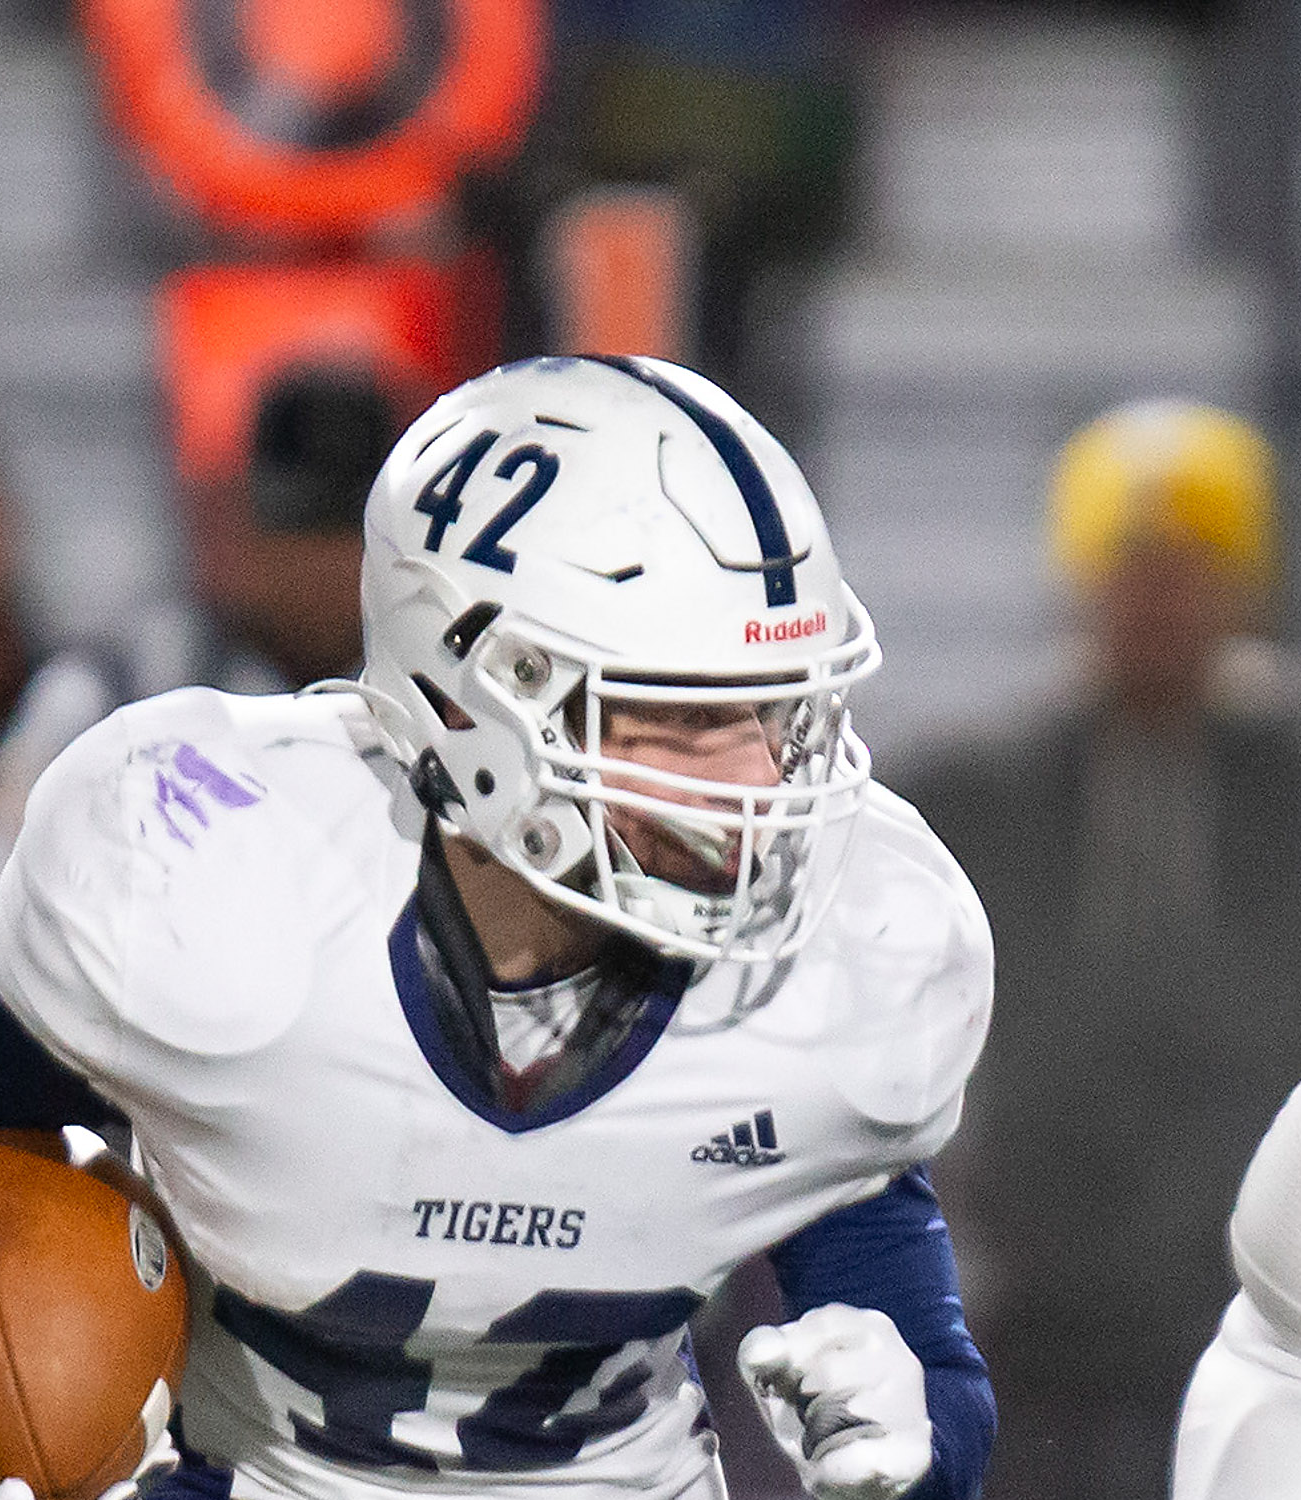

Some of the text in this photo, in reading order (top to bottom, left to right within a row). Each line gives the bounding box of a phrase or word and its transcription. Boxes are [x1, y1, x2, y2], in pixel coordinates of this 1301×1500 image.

[414, 429, 561, 575] 42
[745, 611, 826, 643] Riddell
[413, 1199, 586, 1250] TIGERS
[212, 1268, 708, 1473] 42
